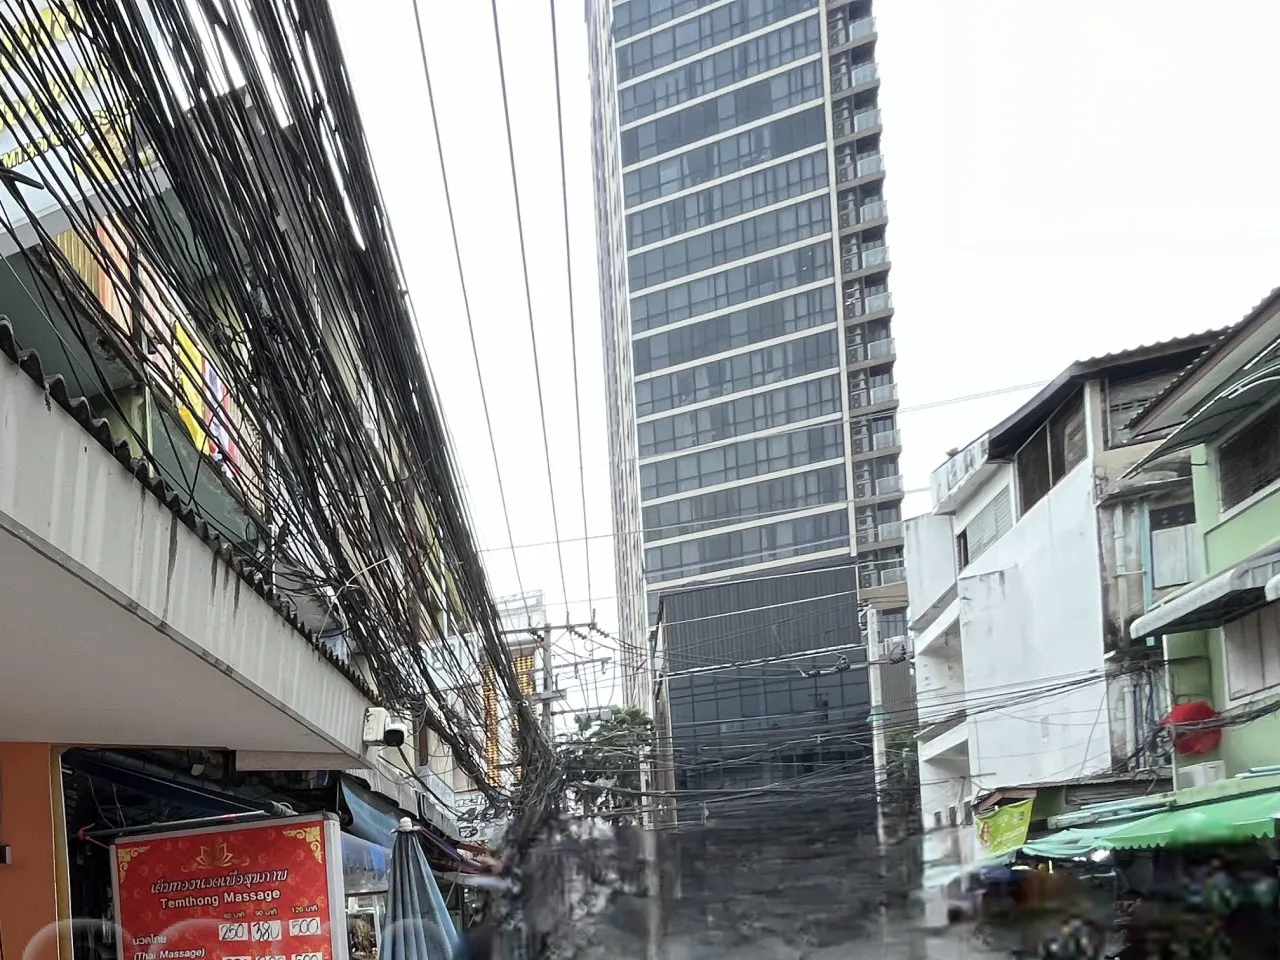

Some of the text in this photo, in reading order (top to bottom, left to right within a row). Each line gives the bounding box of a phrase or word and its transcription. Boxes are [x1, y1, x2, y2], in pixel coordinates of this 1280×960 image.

[160, 889, 280, 909] Temthong Massage
[221, 918, 319, 941] 250 380 500
[133, 934, 167, 946] นวดไทย
[160, 948, 205, 960] Massage)
